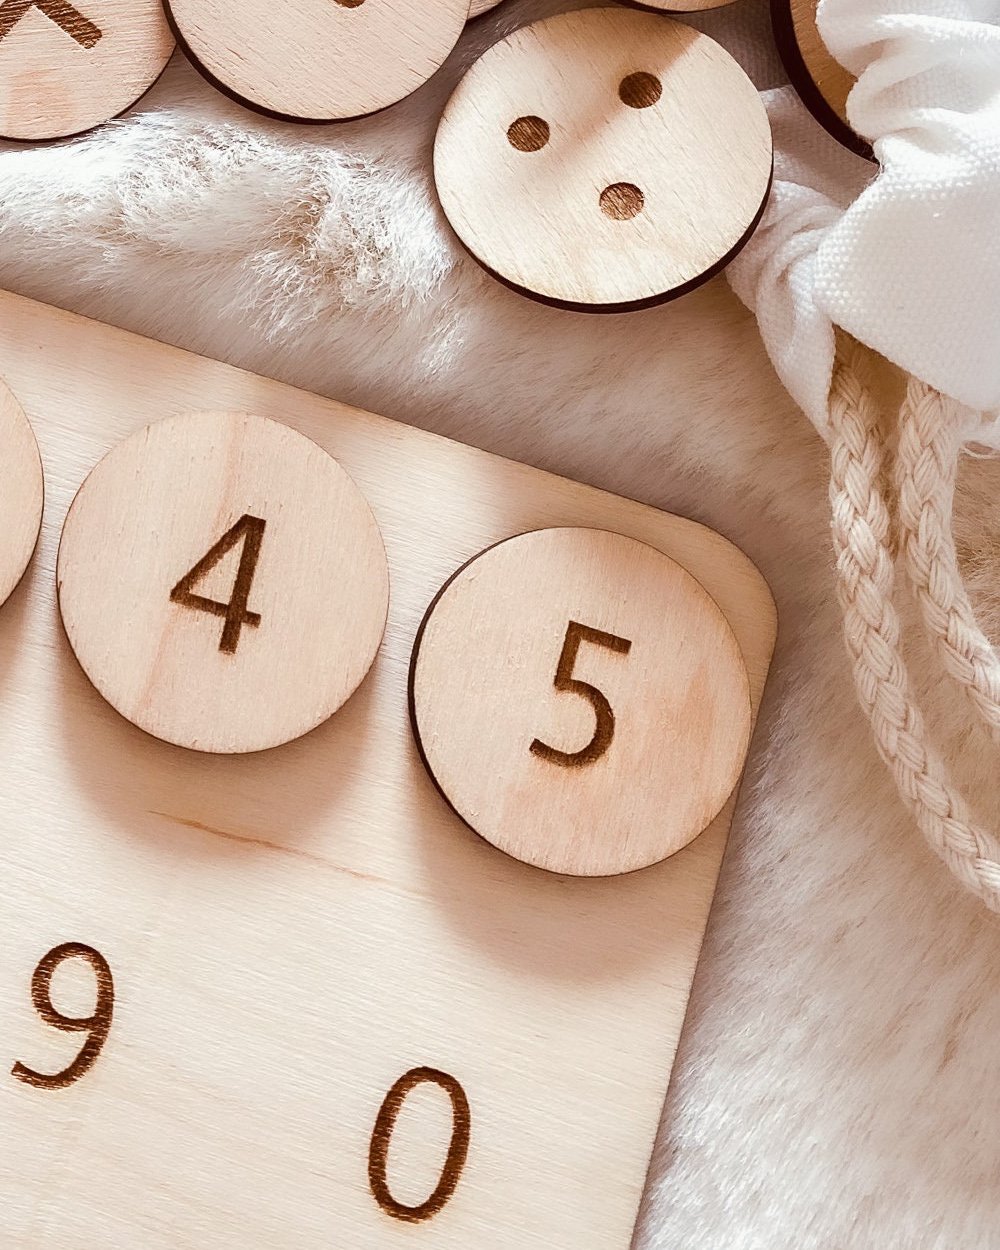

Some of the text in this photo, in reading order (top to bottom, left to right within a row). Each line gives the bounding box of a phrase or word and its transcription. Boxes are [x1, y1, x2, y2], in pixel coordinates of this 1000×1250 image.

[171, 515, 266, 654] 4
[530, 622, 632, 769] 5
[12, 943, 115, 1089] 9
[369, 1067, 471, 1223] 0
